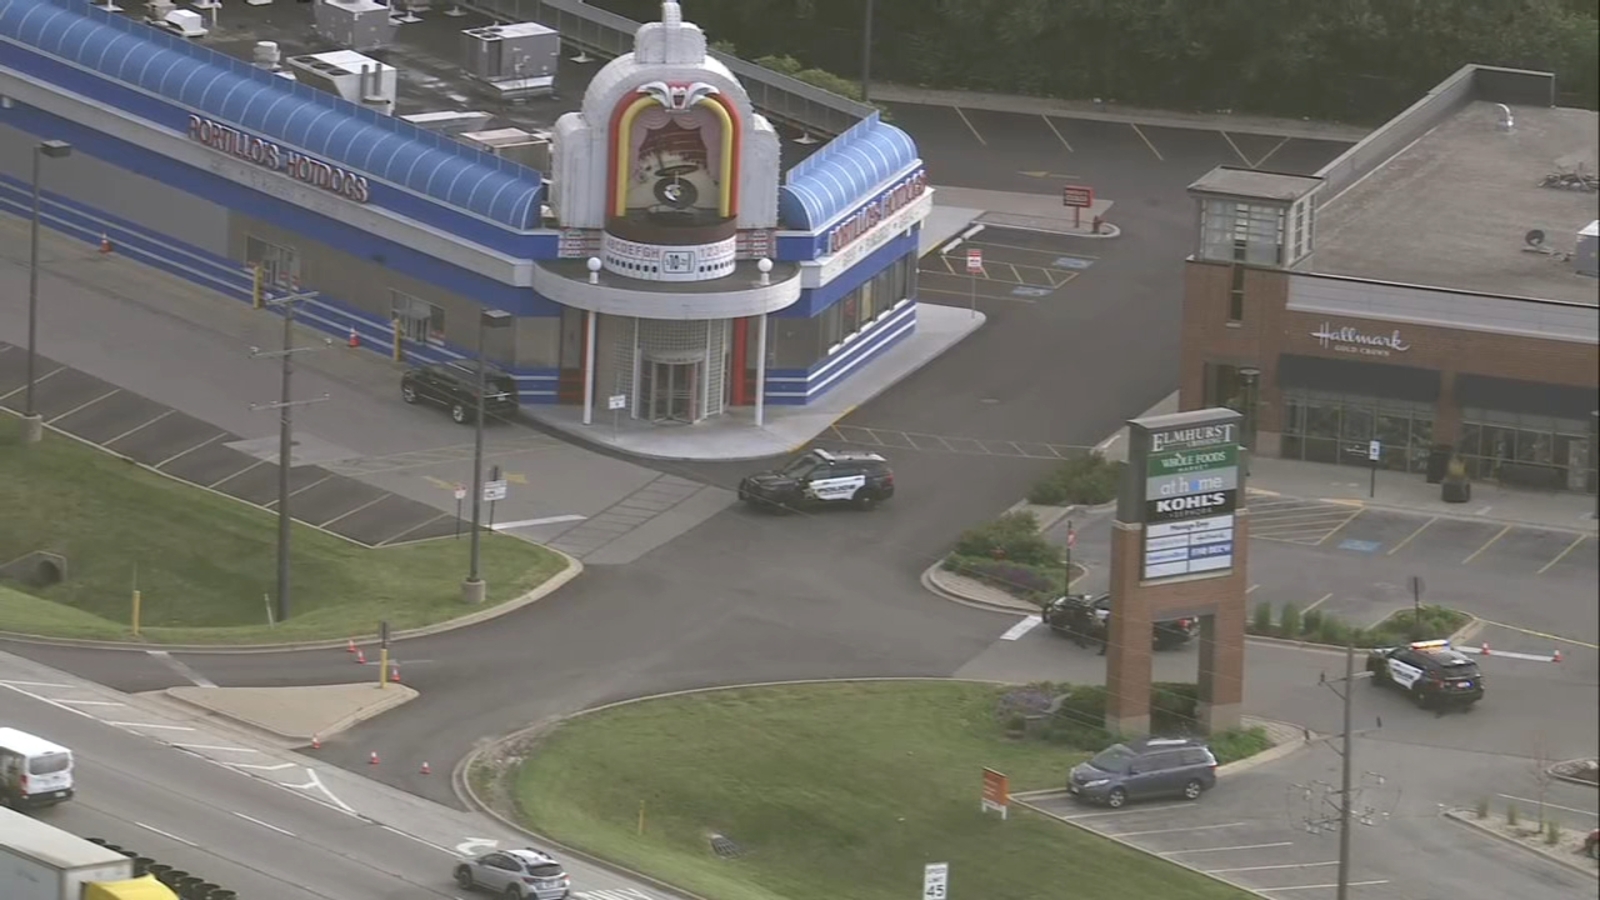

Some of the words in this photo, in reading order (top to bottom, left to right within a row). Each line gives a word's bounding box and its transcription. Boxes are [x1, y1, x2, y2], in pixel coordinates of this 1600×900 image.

[188, 114, 280, 170] PORTILLO'S
[1310, 321, 1411, 351] Hallmark
[1334, 345, 1357, 353] GOLD
[1151, 423, 1236, 452] ELMHURST
[1161, 454, 1194, 468] WHOLE
[1196, 451, 1226, 464] FOODS
[1161, 481, 1176, 495] at
[1178, 476, 1222, 493] home
[1156, 492, 1226, 513] KOHL'S
[926, 884, 945, 898] 45
